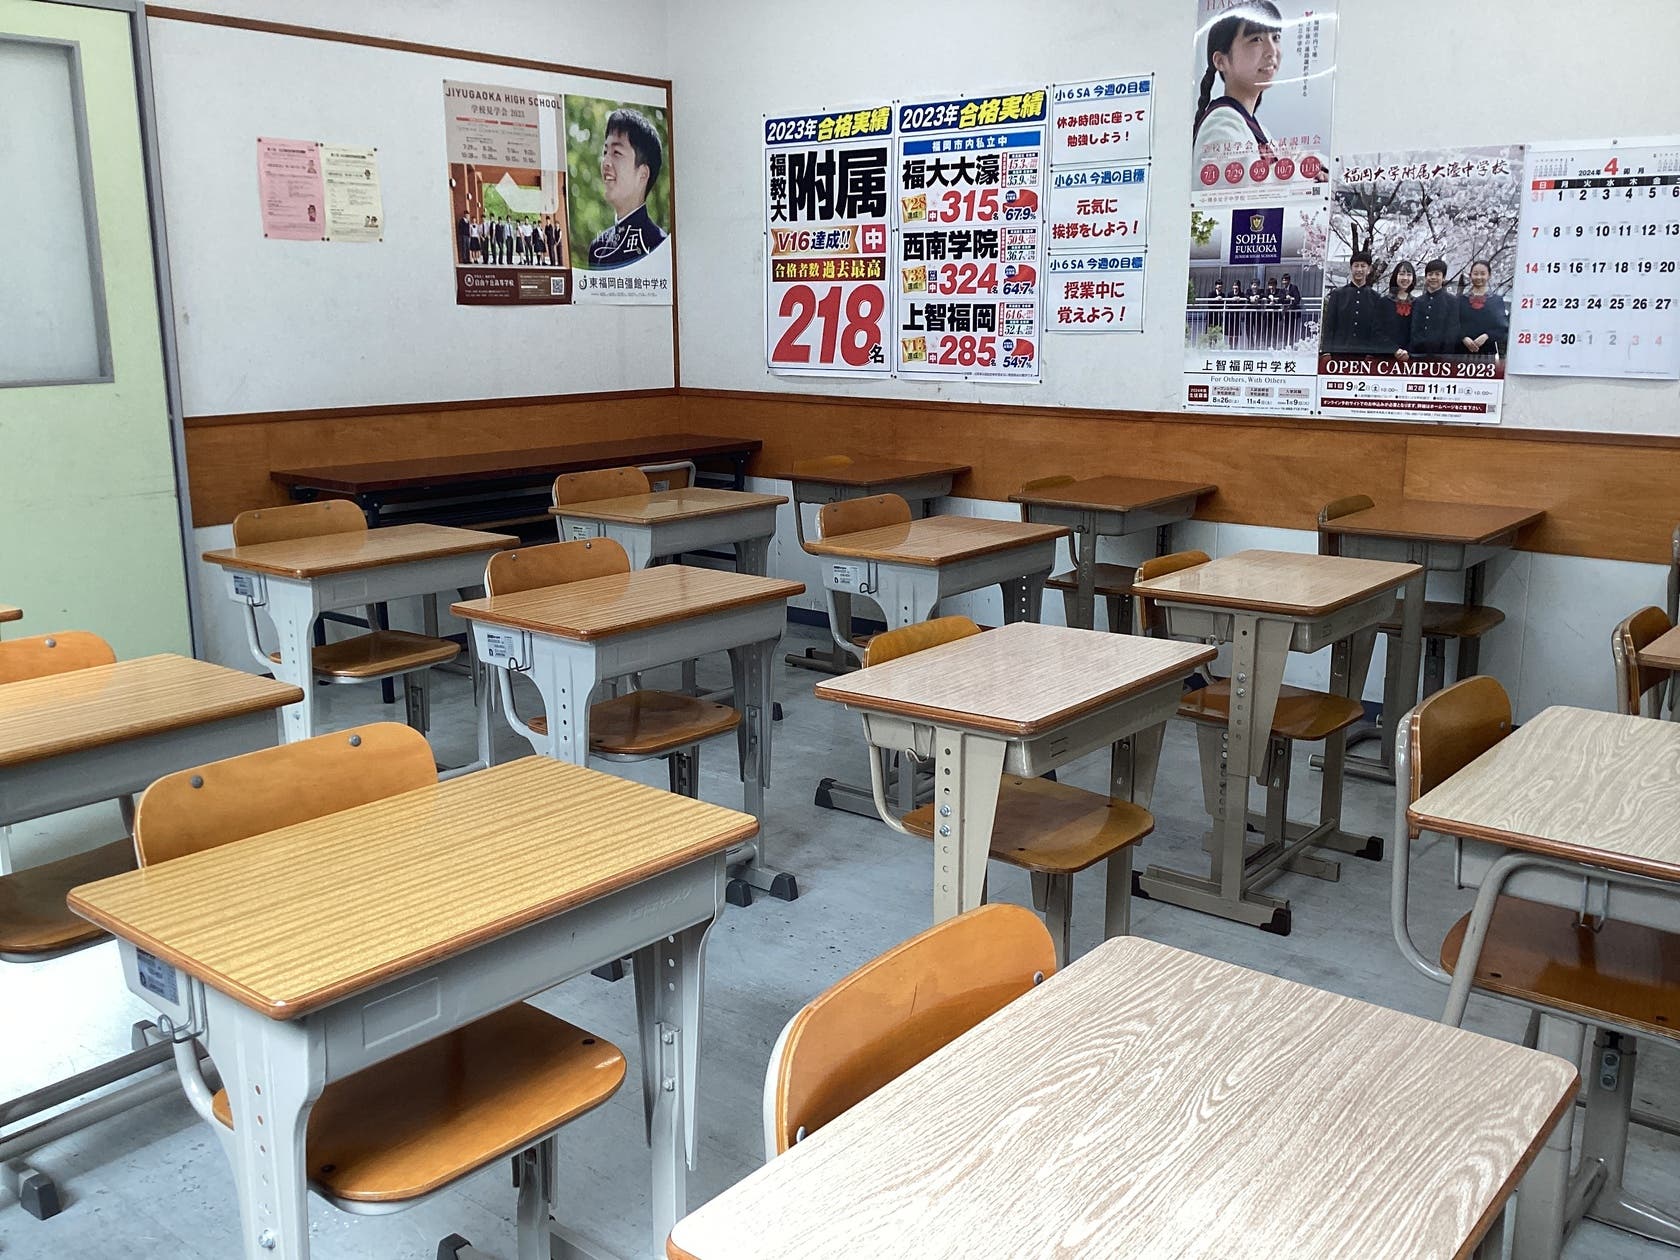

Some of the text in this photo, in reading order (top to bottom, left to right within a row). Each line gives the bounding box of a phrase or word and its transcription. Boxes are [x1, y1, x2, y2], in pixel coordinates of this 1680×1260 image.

[1093, 80, 1151, 97] 今週の目標
[445, 88, 562, 109] JIYUGAOKA HIGH SCHOOL
[471, 105, 508, 116] 学校見学会
[1057, 110, 1145, 129] 休み時間に座って
[932, 136, 1008, 152] 福岡市内私立中
[902, 154, 1000, 190] 福大大濠
[1253, 167, 1266, 176] 9/9
[1277, 165, 1292, 175] 10/7
[1578, 169, 1601, 177] 2024年
[1604, 157, 1619, 176] 4
[1090, 168, 1145, 184] 今週の目標
[1539, 181, 1547, 189] 日
[1583, 179, 1592, 187] 火
[1606, 178, 1615, 186] 水
[1629, 177, 1638, 185] 木
[1652, 176, 1661, 185] 金
[770, 154, 787, 222] 福教大
[788, 147, 888, 222] 附属
[1558, 190, 1564, 201] 1
[1579, 189, 1587, 200] 2
[1602, 189, 1610, 200] 3
[1625, 188, 1633, 199] 4
[1648, 187, 1657, 198] 5
[1672, 186, 1680, 197] 6
[1076, 198, 1118, 215] 元気に
[865, 227, 883, 250] 中
[1235, 233, 1278, 244] SOPHIA
[1531, 223, 1680, 238] 7 8 9 10 11 12 13
[902, 229, 999, 261] 西南学院
[1235, 244, 1277, 253] FUKUOKA
[775, 259, 881, 279] 合格者数 過去最高
[1087, 257, 1143, 270] 今週の目標
[1526, 261, 1676, 273] 14 15 16 17 18 19 20
[1003, 283, 1034, 295] 64.7%
[1064, 280, 1125, 299] 授業中に
[1521, 298, 1672, 310] 21 22 23 24 25 26 27
[902, 303, 997, 332] 上智福岡
[1518, 333, 1662, 346] 28 29 30 1 2 3 4
[1002, 356, 1032, 368] 54.7%
[1202, 360, 1297, 373] 上智福岡中学校
[1326, 359, 1496, 378] OPEN CAMPUS 2023
